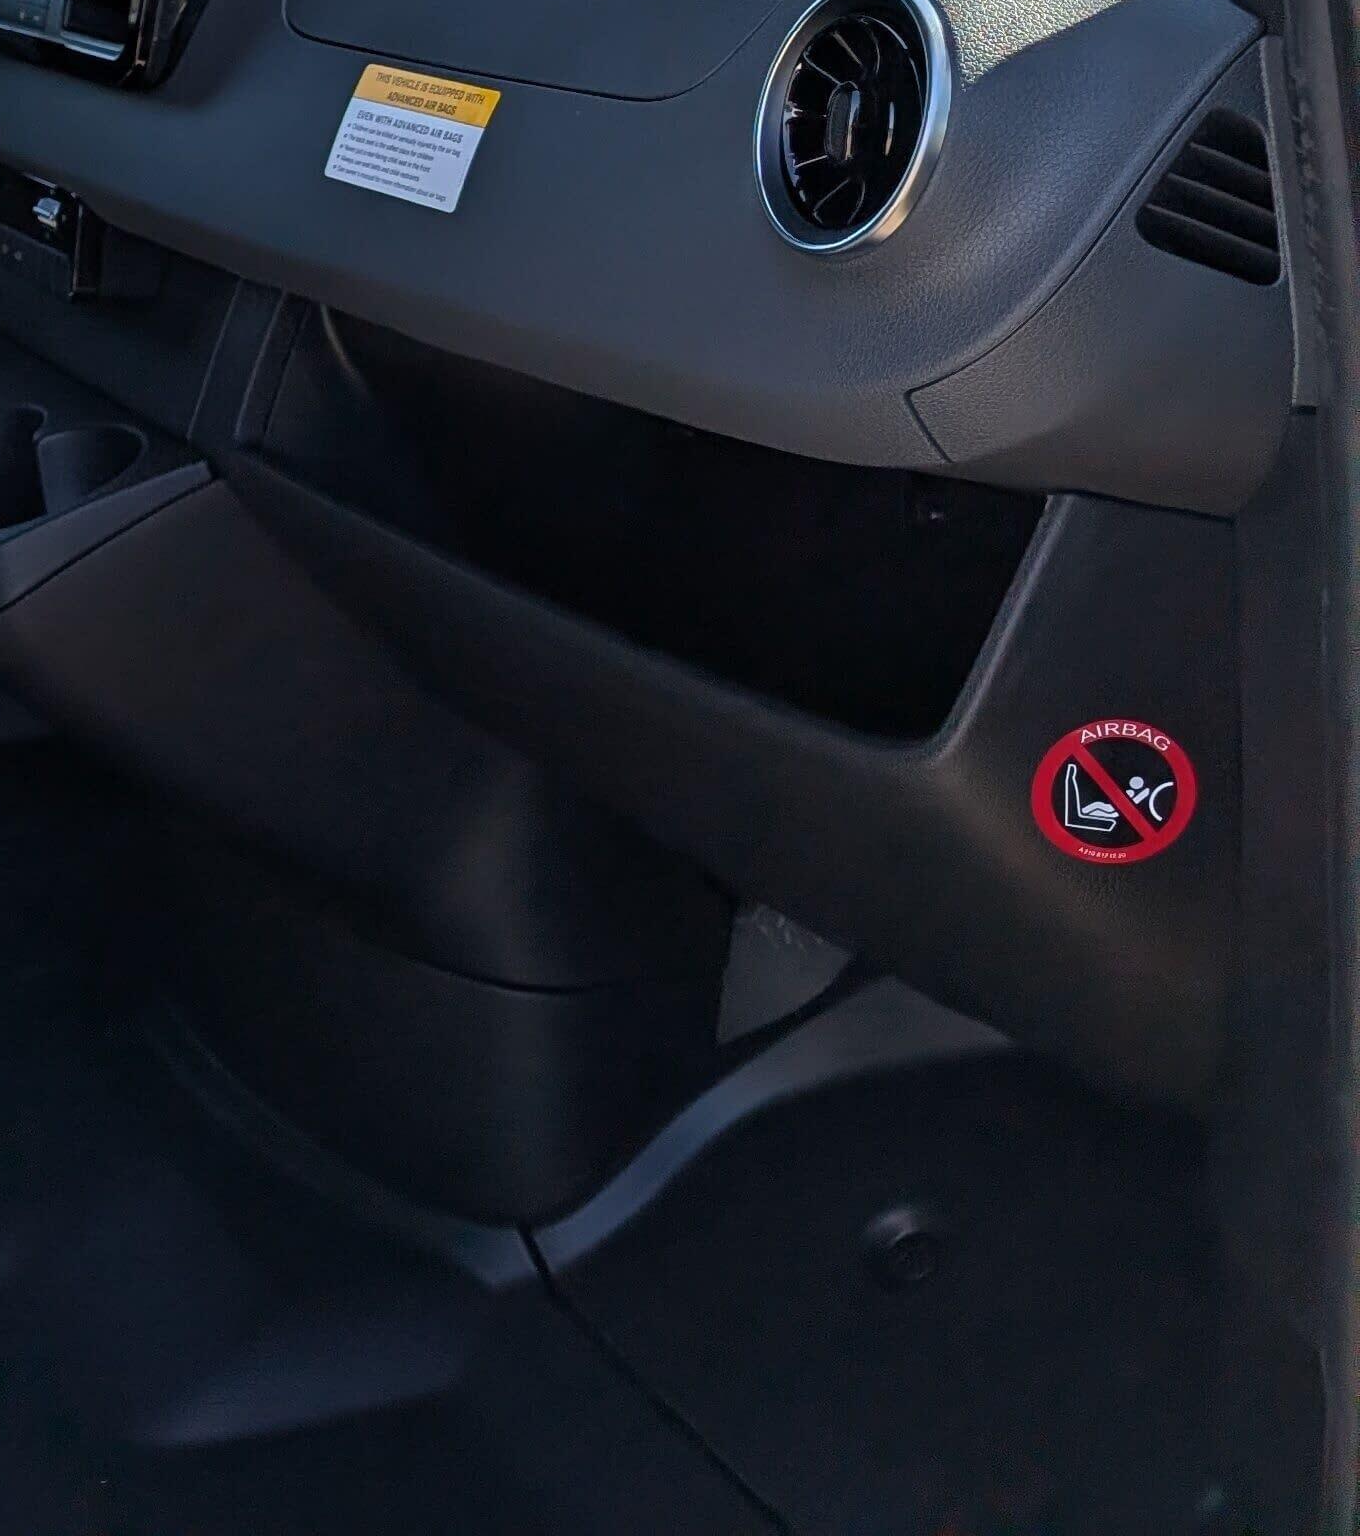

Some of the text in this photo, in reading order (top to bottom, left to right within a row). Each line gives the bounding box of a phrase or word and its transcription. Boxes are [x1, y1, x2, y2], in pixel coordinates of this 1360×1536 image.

[376, 72, 486, 105] THIS VEHICLE IS EQUIPPED WITH
[387, 91, 458, 116] ADVANCED AIR BAGS
[356, 109, 464, 144] EVEN WITH ADVANCED AIR BAGS
[1080, 722, 1171, 752] AIRBAG
